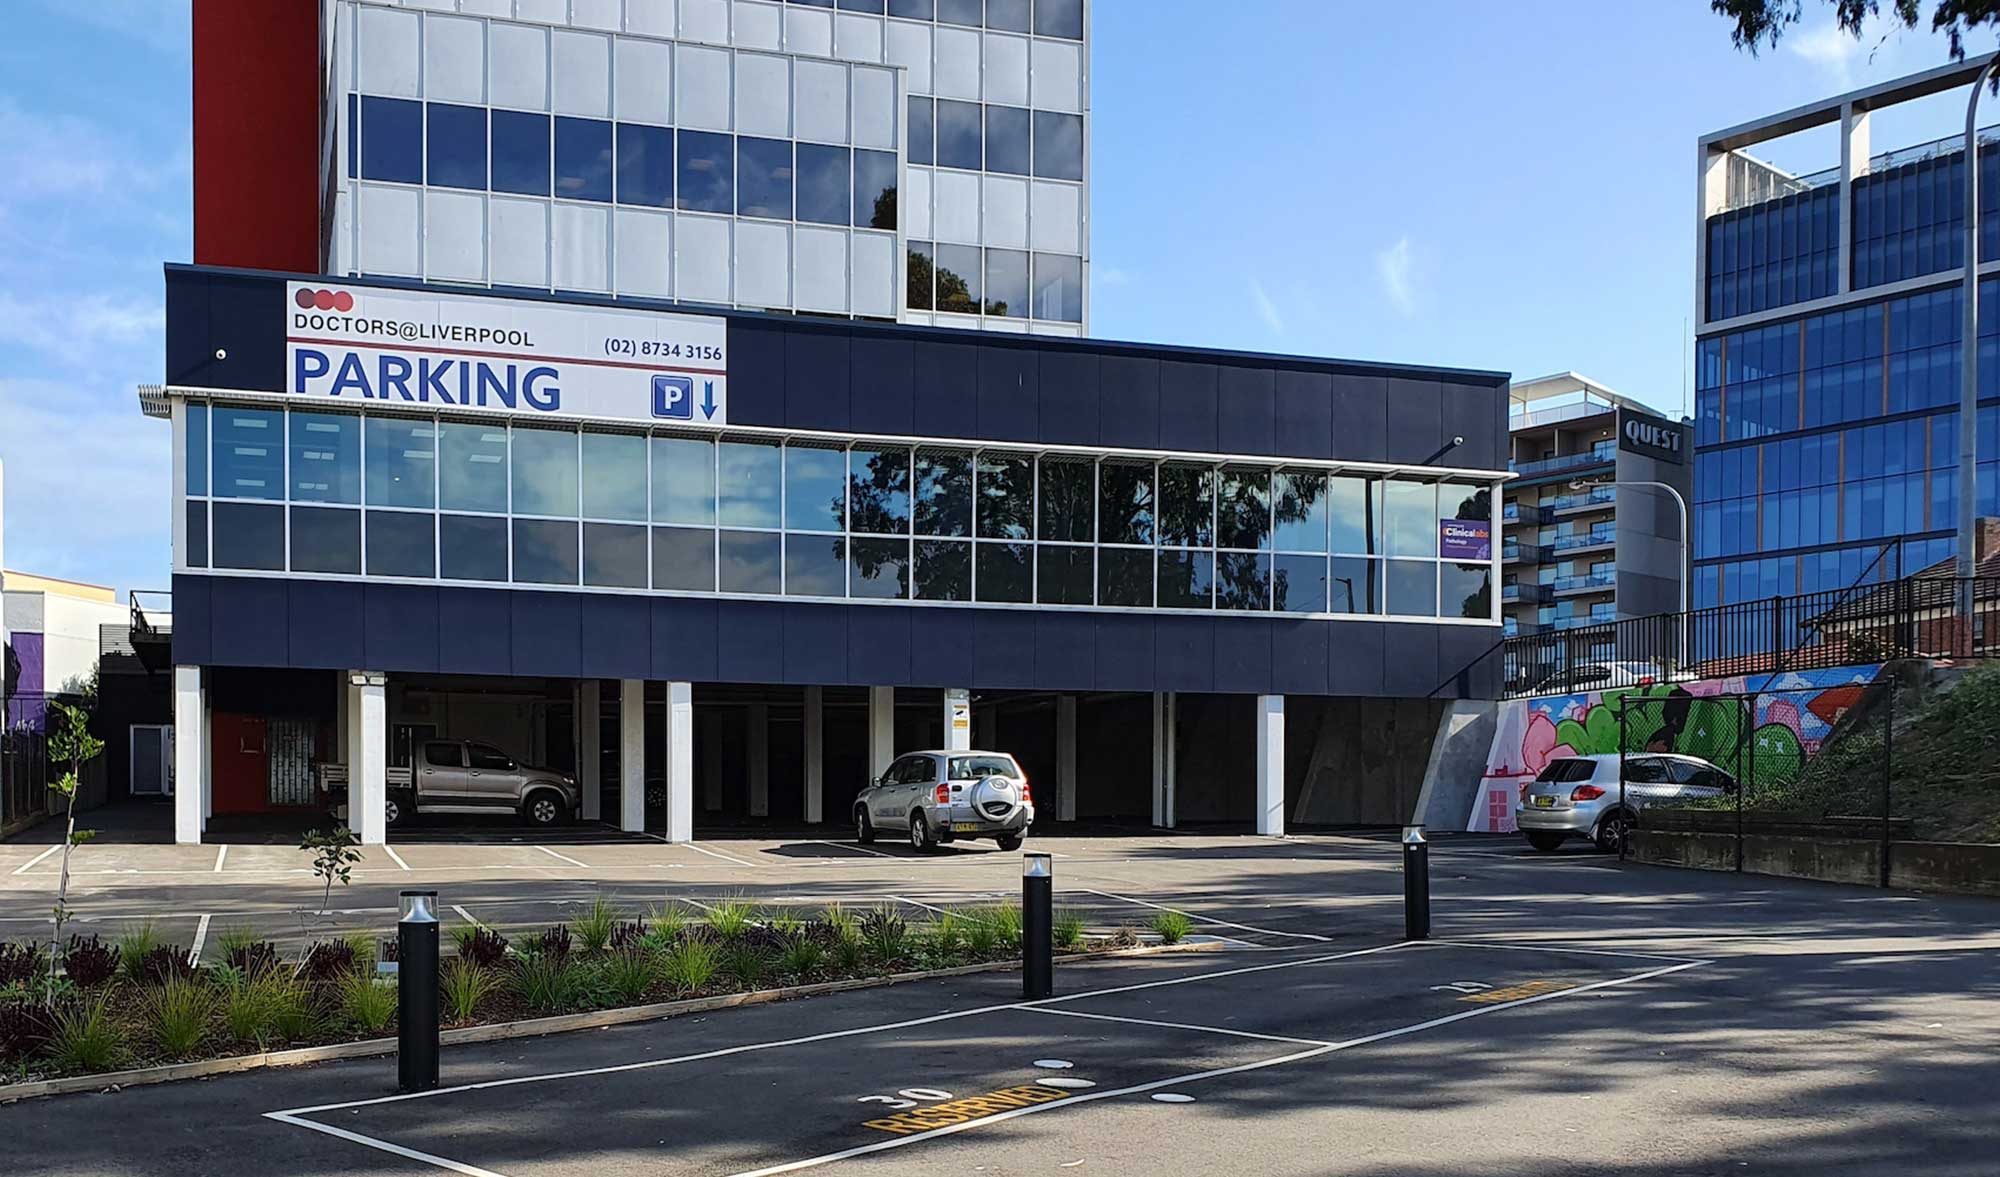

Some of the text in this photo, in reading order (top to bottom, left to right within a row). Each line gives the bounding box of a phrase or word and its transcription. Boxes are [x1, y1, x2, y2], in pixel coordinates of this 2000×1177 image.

[294, 313, 535, 347] DOCTORS@LIVERPOOL
[604, 338, 722, 361] (02) 8734 3156
[295, 348, 560, 411] PARKING
[664, 385, 683, 410] P
[1625, 420, 1680, 451] QUEST
[857, 1087, 954, 1109] 30
[861, 1085, 1072, 1134] RESERVED
